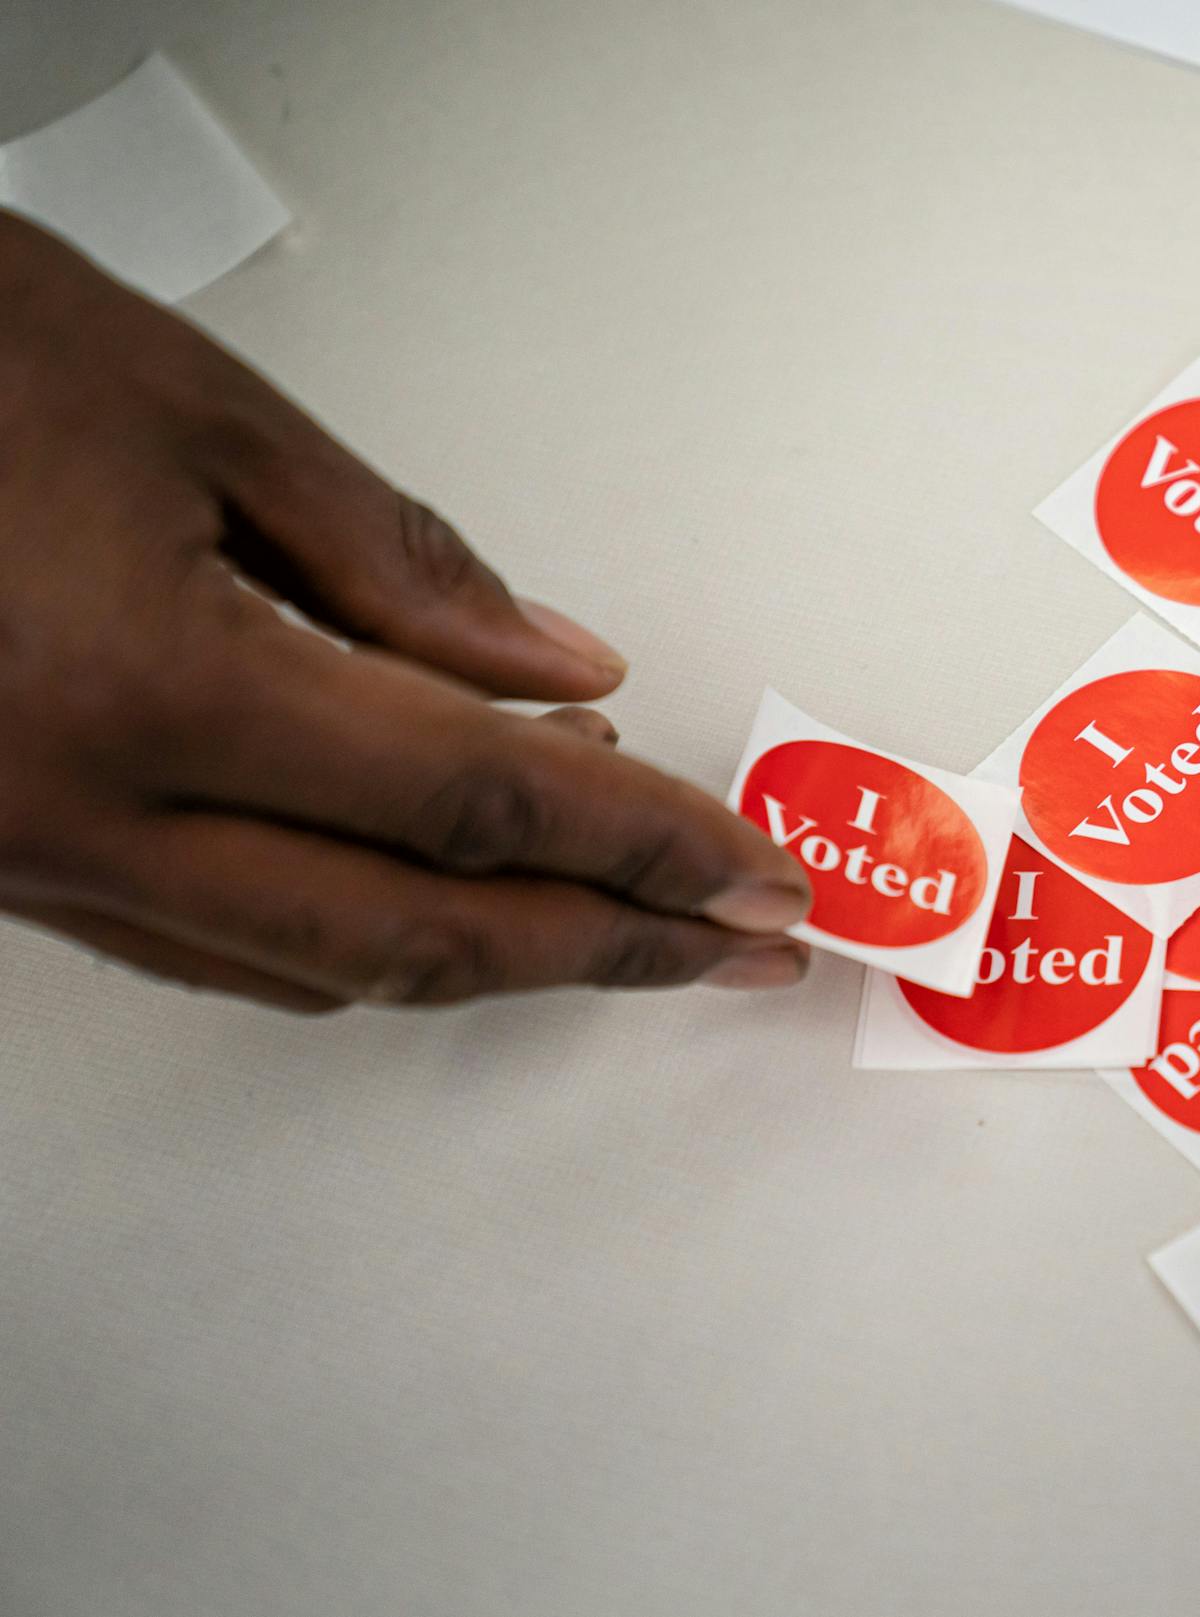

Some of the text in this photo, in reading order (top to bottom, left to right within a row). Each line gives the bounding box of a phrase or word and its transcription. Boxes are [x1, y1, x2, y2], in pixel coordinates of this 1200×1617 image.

[1072, 719, 1135, 769] I
[846, 785, 888, 836] I
[762, 793, 958, 917] Voted
[1007, 870, 1045, 921] I
[975, 935, 1125, 986] oted
